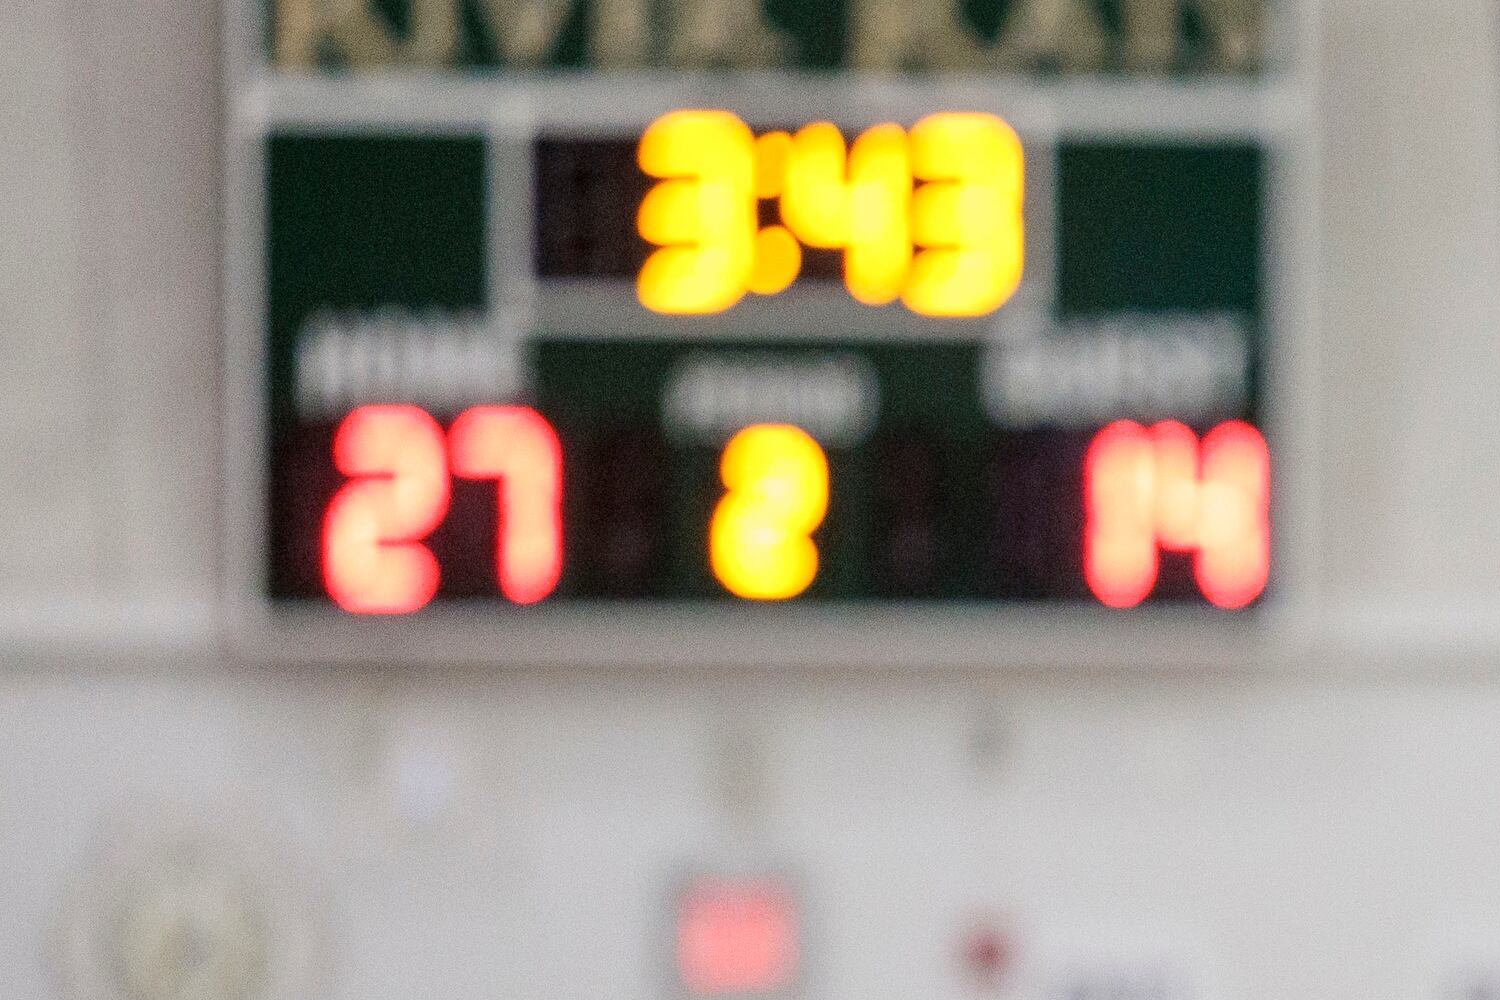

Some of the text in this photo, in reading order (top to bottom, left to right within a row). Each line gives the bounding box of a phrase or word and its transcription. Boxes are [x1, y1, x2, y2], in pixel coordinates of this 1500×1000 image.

[637, 109, 1026, 319] 3:43
[321, 403, 564, 616] 27
[710, 423, 829, 600] 2
[1083, 419, 1272, 610] 14
